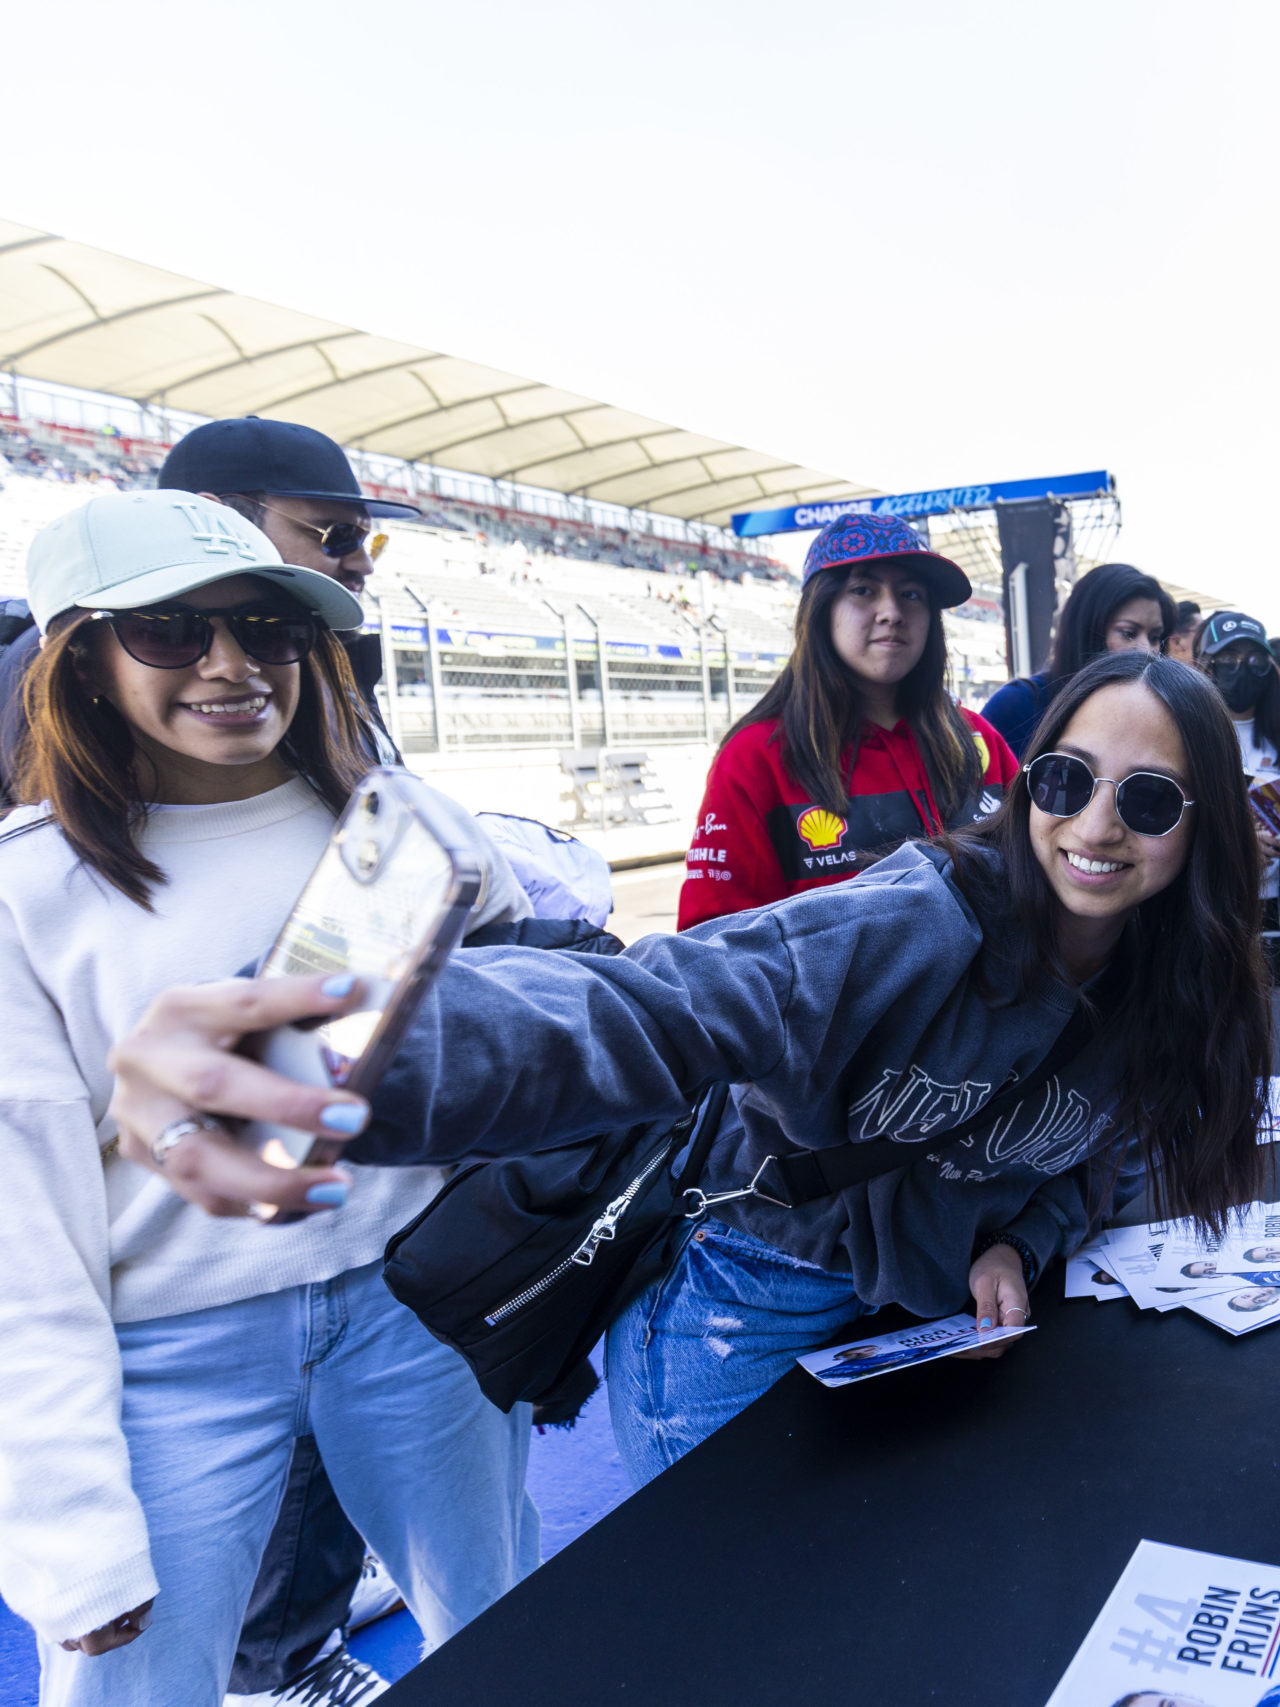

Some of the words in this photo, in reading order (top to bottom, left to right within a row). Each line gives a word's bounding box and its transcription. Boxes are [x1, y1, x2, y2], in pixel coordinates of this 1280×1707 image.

[795, 501, 873, 525] CHANGE
[876, 486, 990, 516] ACCELERATED
[816, 851, 857, 867] VELAS
[898, 1329, 948, 1345] NICO
[1110, 1593, 1199, 1675] #4
[1176, 1585, 1241, 1667] ROBIN
